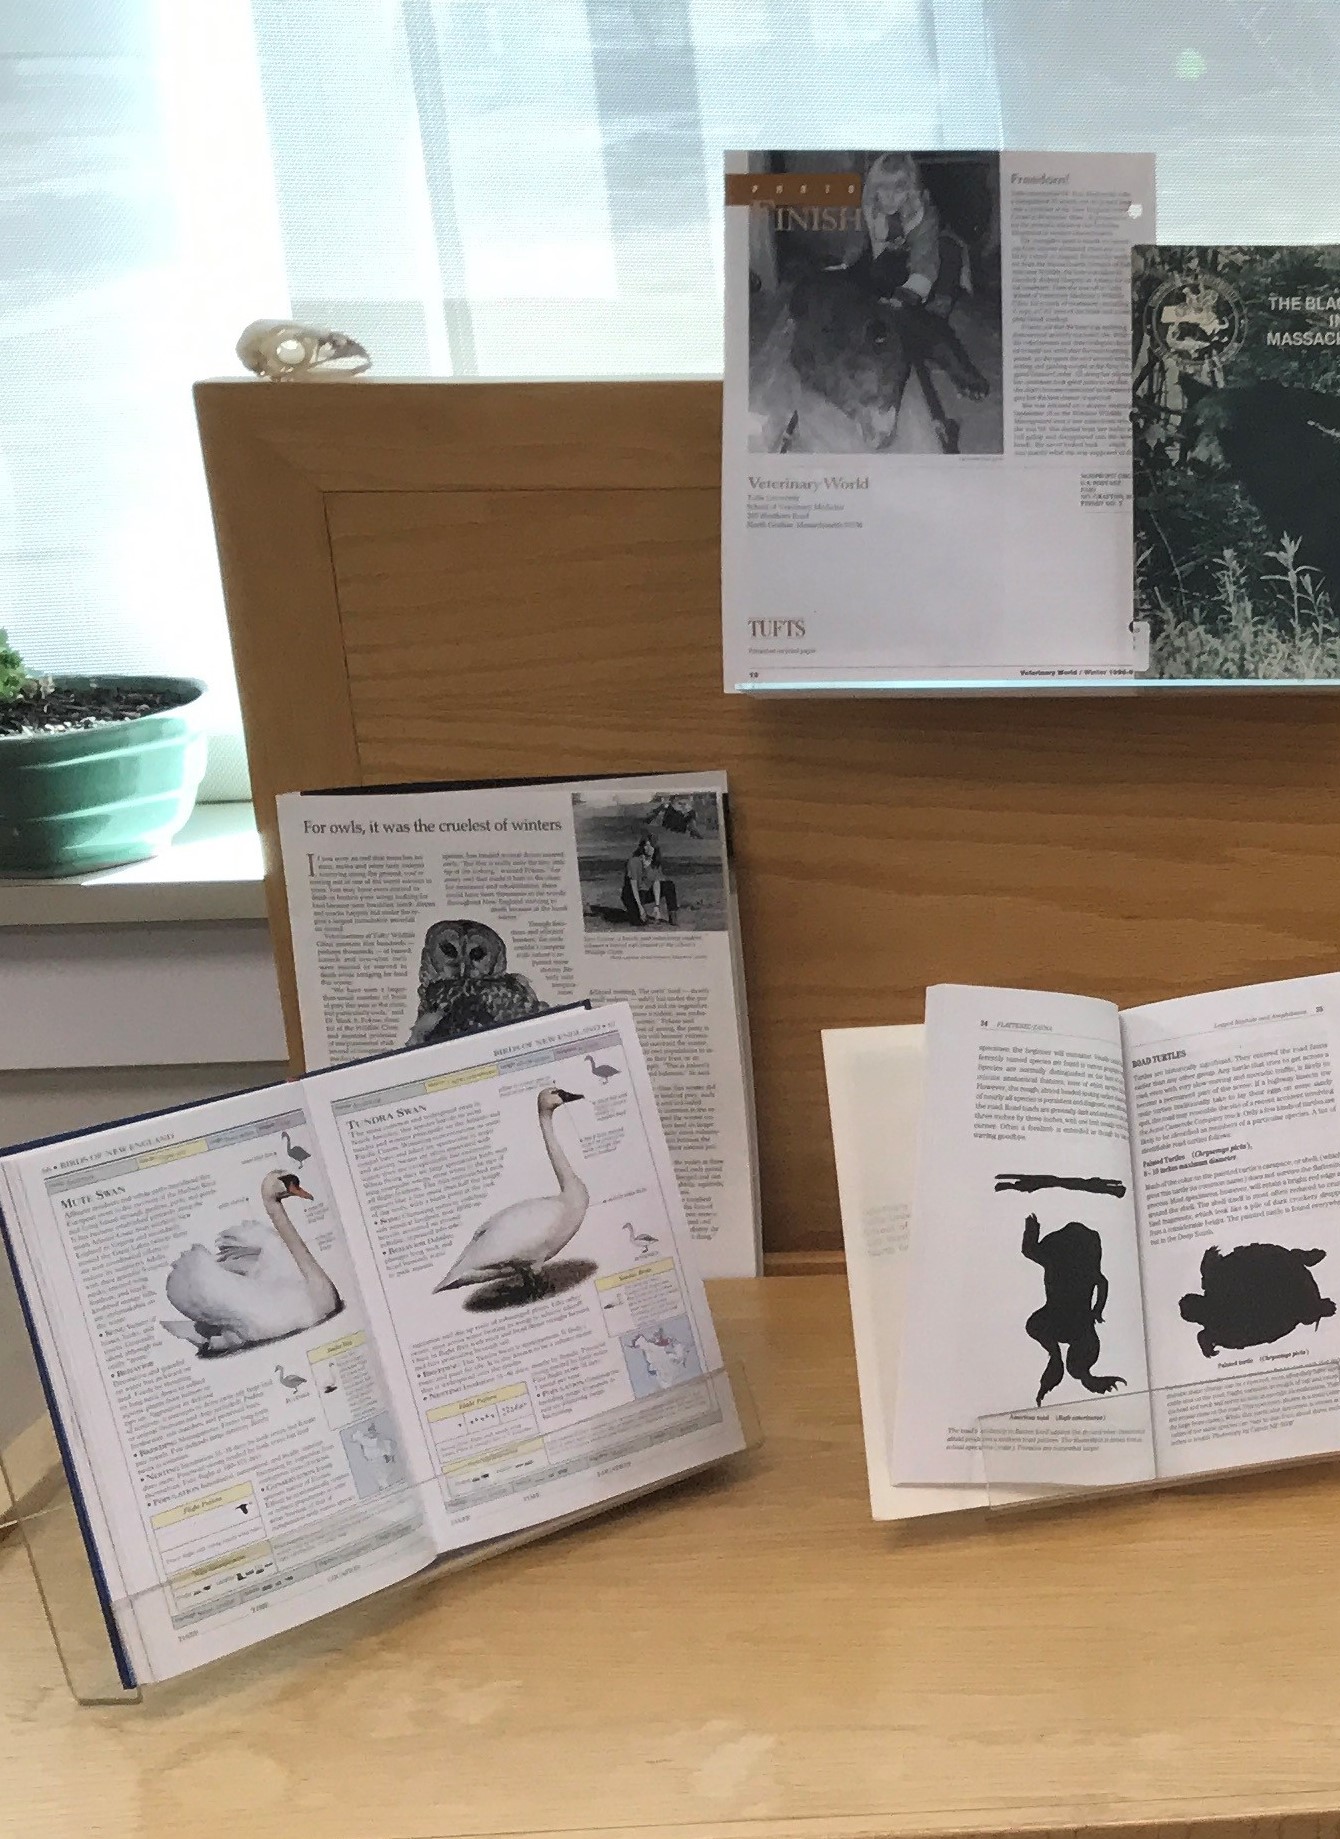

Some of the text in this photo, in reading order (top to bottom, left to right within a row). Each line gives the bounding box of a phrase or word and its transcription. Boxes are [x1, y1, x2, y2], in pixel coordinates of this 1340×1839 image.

[1268, 296, 1300, 311] THE
[748, 477, 869, 492] Veterinary World
[748, 620, 806, 637] TUFTS
[304, 818, 562, 836] For owls, it was the cruelest of winters
[1132, 1050, 1186, 1068] ROAD TURTLES
[347, 1103, 428, 1130] TUNDRA SWAN
[60, 1185, 127, 1209] MUTE SWAN
